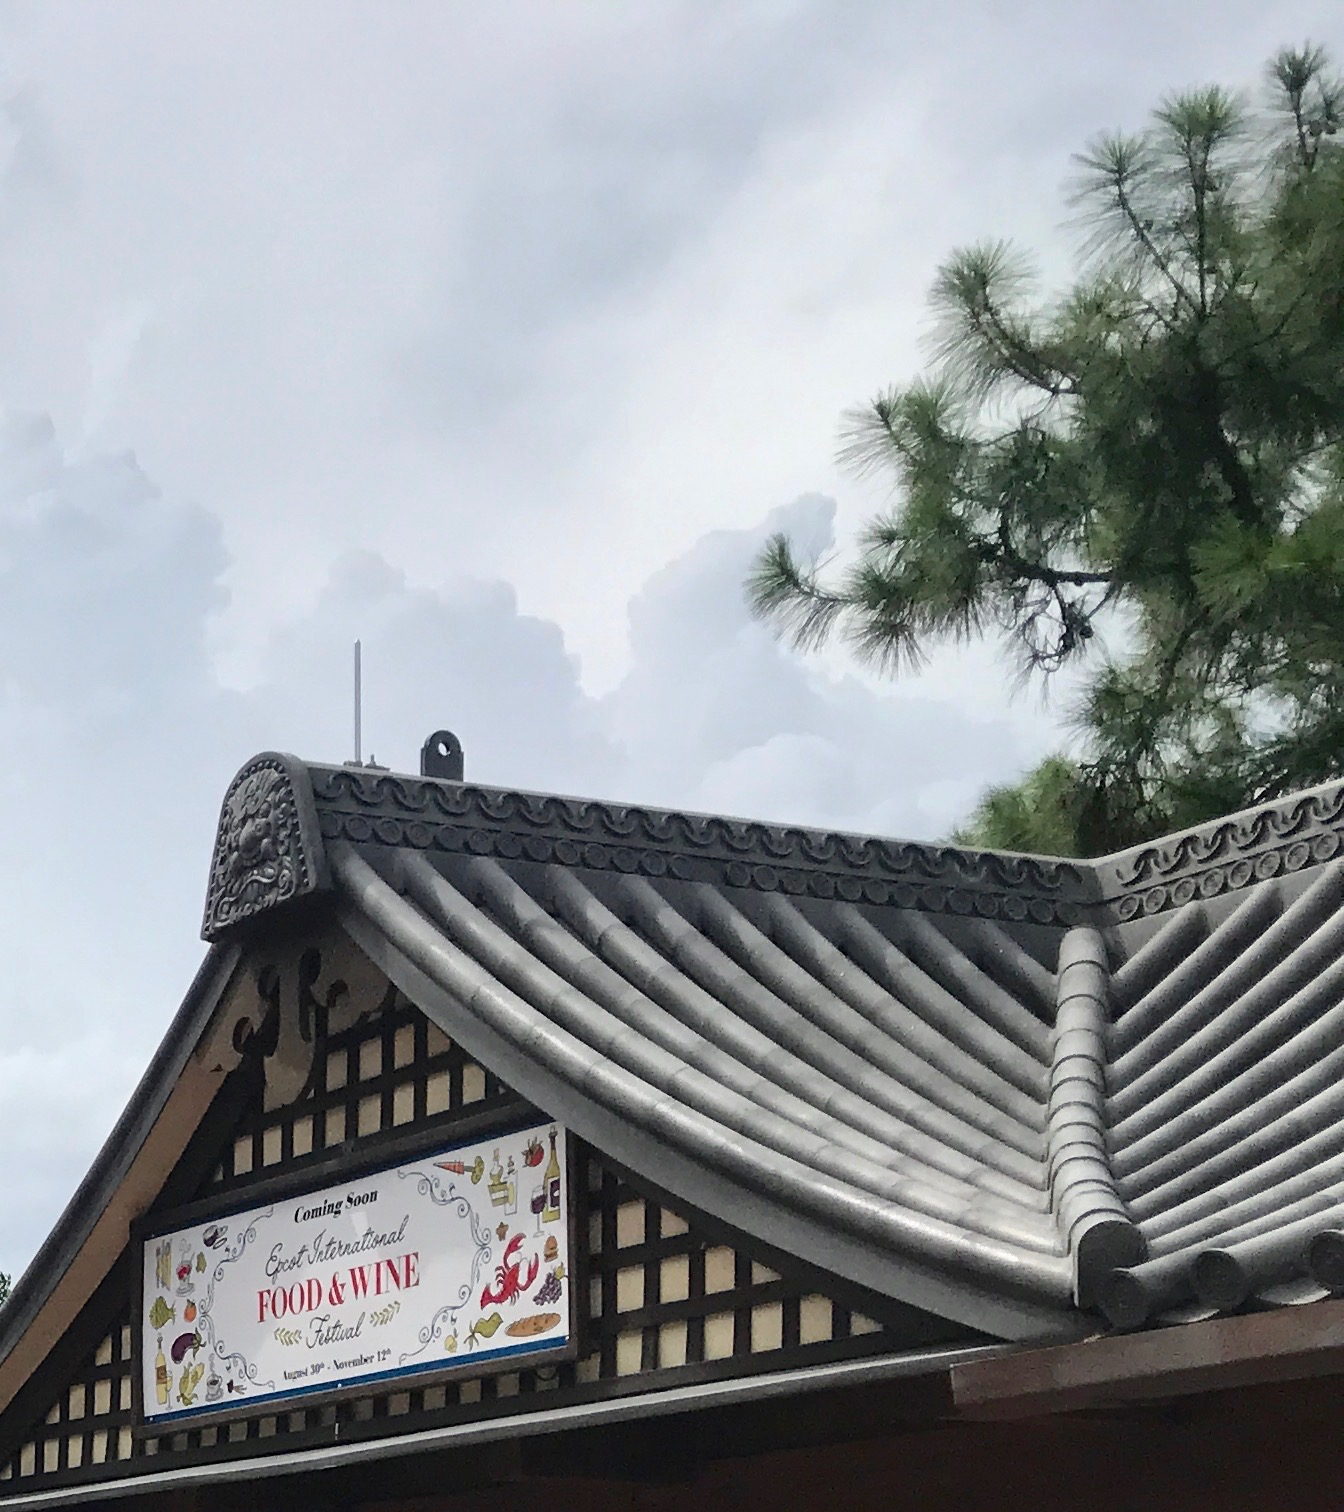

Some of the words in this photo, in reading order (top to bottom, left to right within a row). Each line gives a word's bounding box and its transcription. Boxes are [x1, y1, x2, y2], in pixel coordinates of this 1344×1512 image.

[294, 1199, 344, 1223] Coming
[345, 1190, 378, 1210] Soon
[265, 1243, 309, 1285] Epcot
[308, 1214, 410, 1265] International
[256, 1277, 323, 1323] FOOD
[328, 1271, 346, 1306] &
[348, 1251, 420, 1301] WINE
[306, 1311, 366, 1349] Festival
[333, 1353, 374, 1370] November
